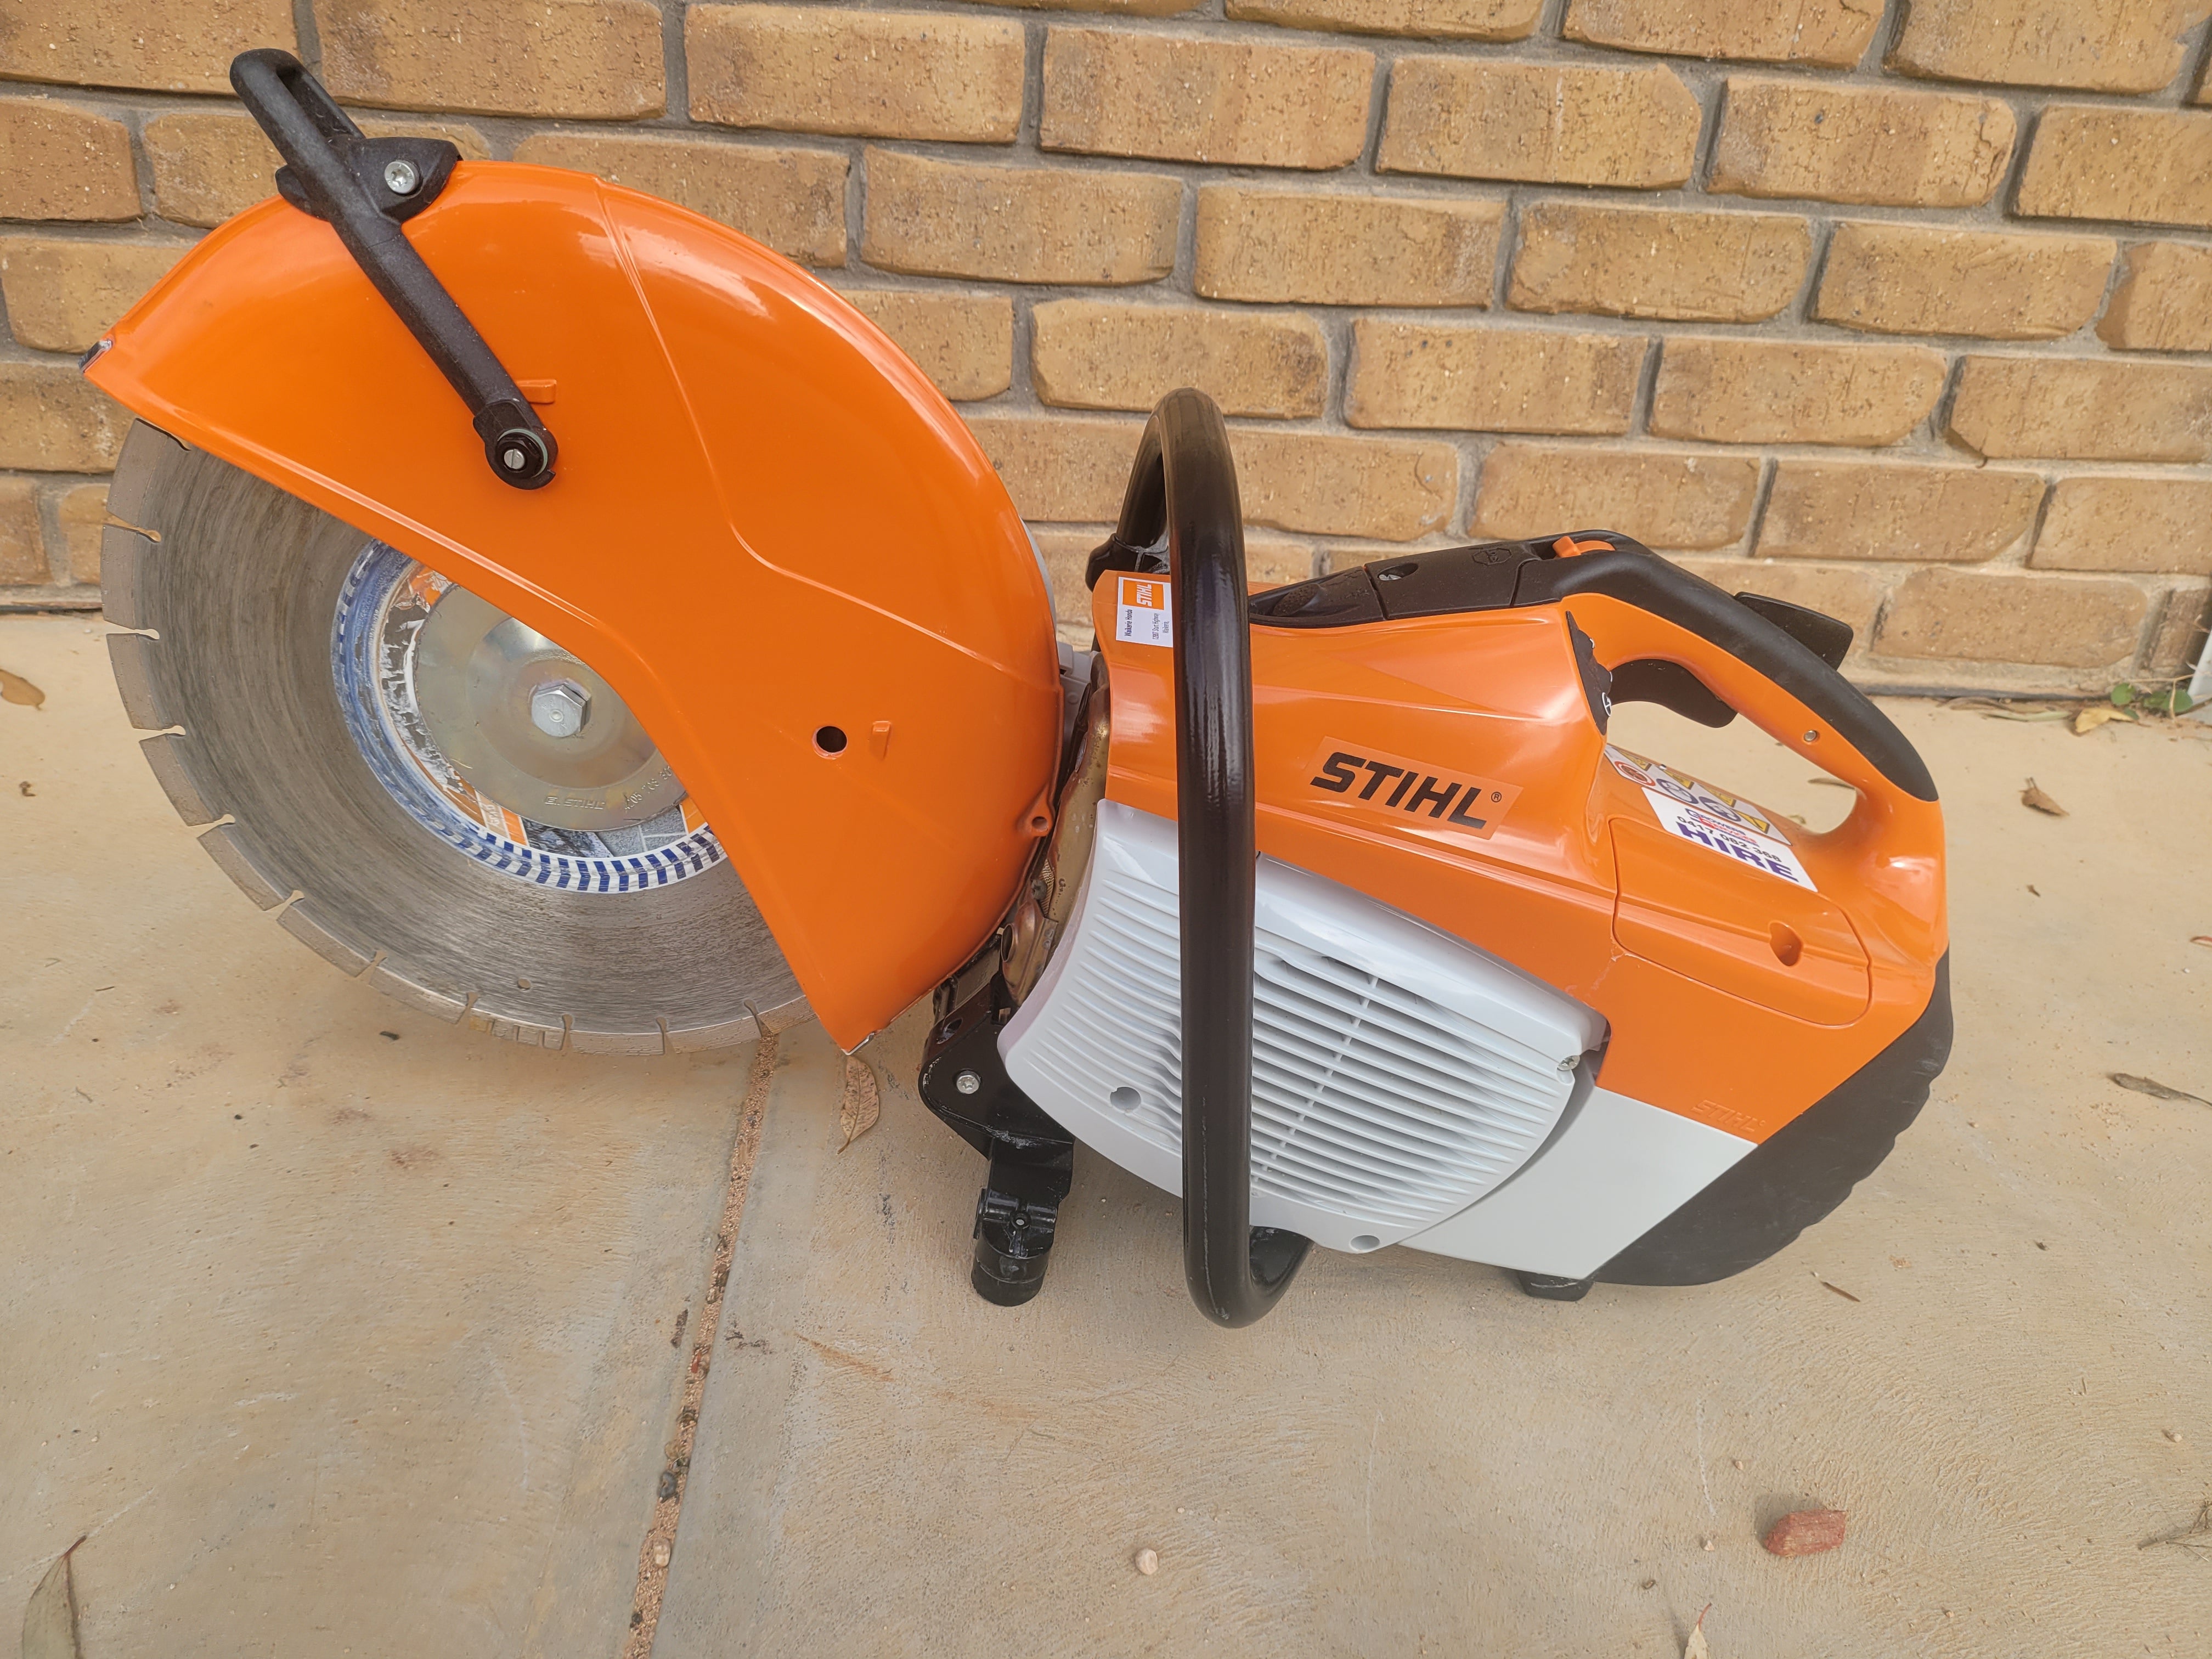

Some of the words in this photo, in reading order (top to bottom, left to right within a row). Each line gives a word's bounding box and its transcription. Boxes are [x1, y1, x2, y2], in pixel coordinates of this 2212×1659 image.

[1137, 584, 1152, 606] STIHL
[1125, 609, 1133, 620] Honda
[561, 798, 606, 810] STIHL
[1677, 816, 1714, 834] 0417
[1719, 833, 1750, 850] 082
[1675, 821, 1799, 883] HIRE
